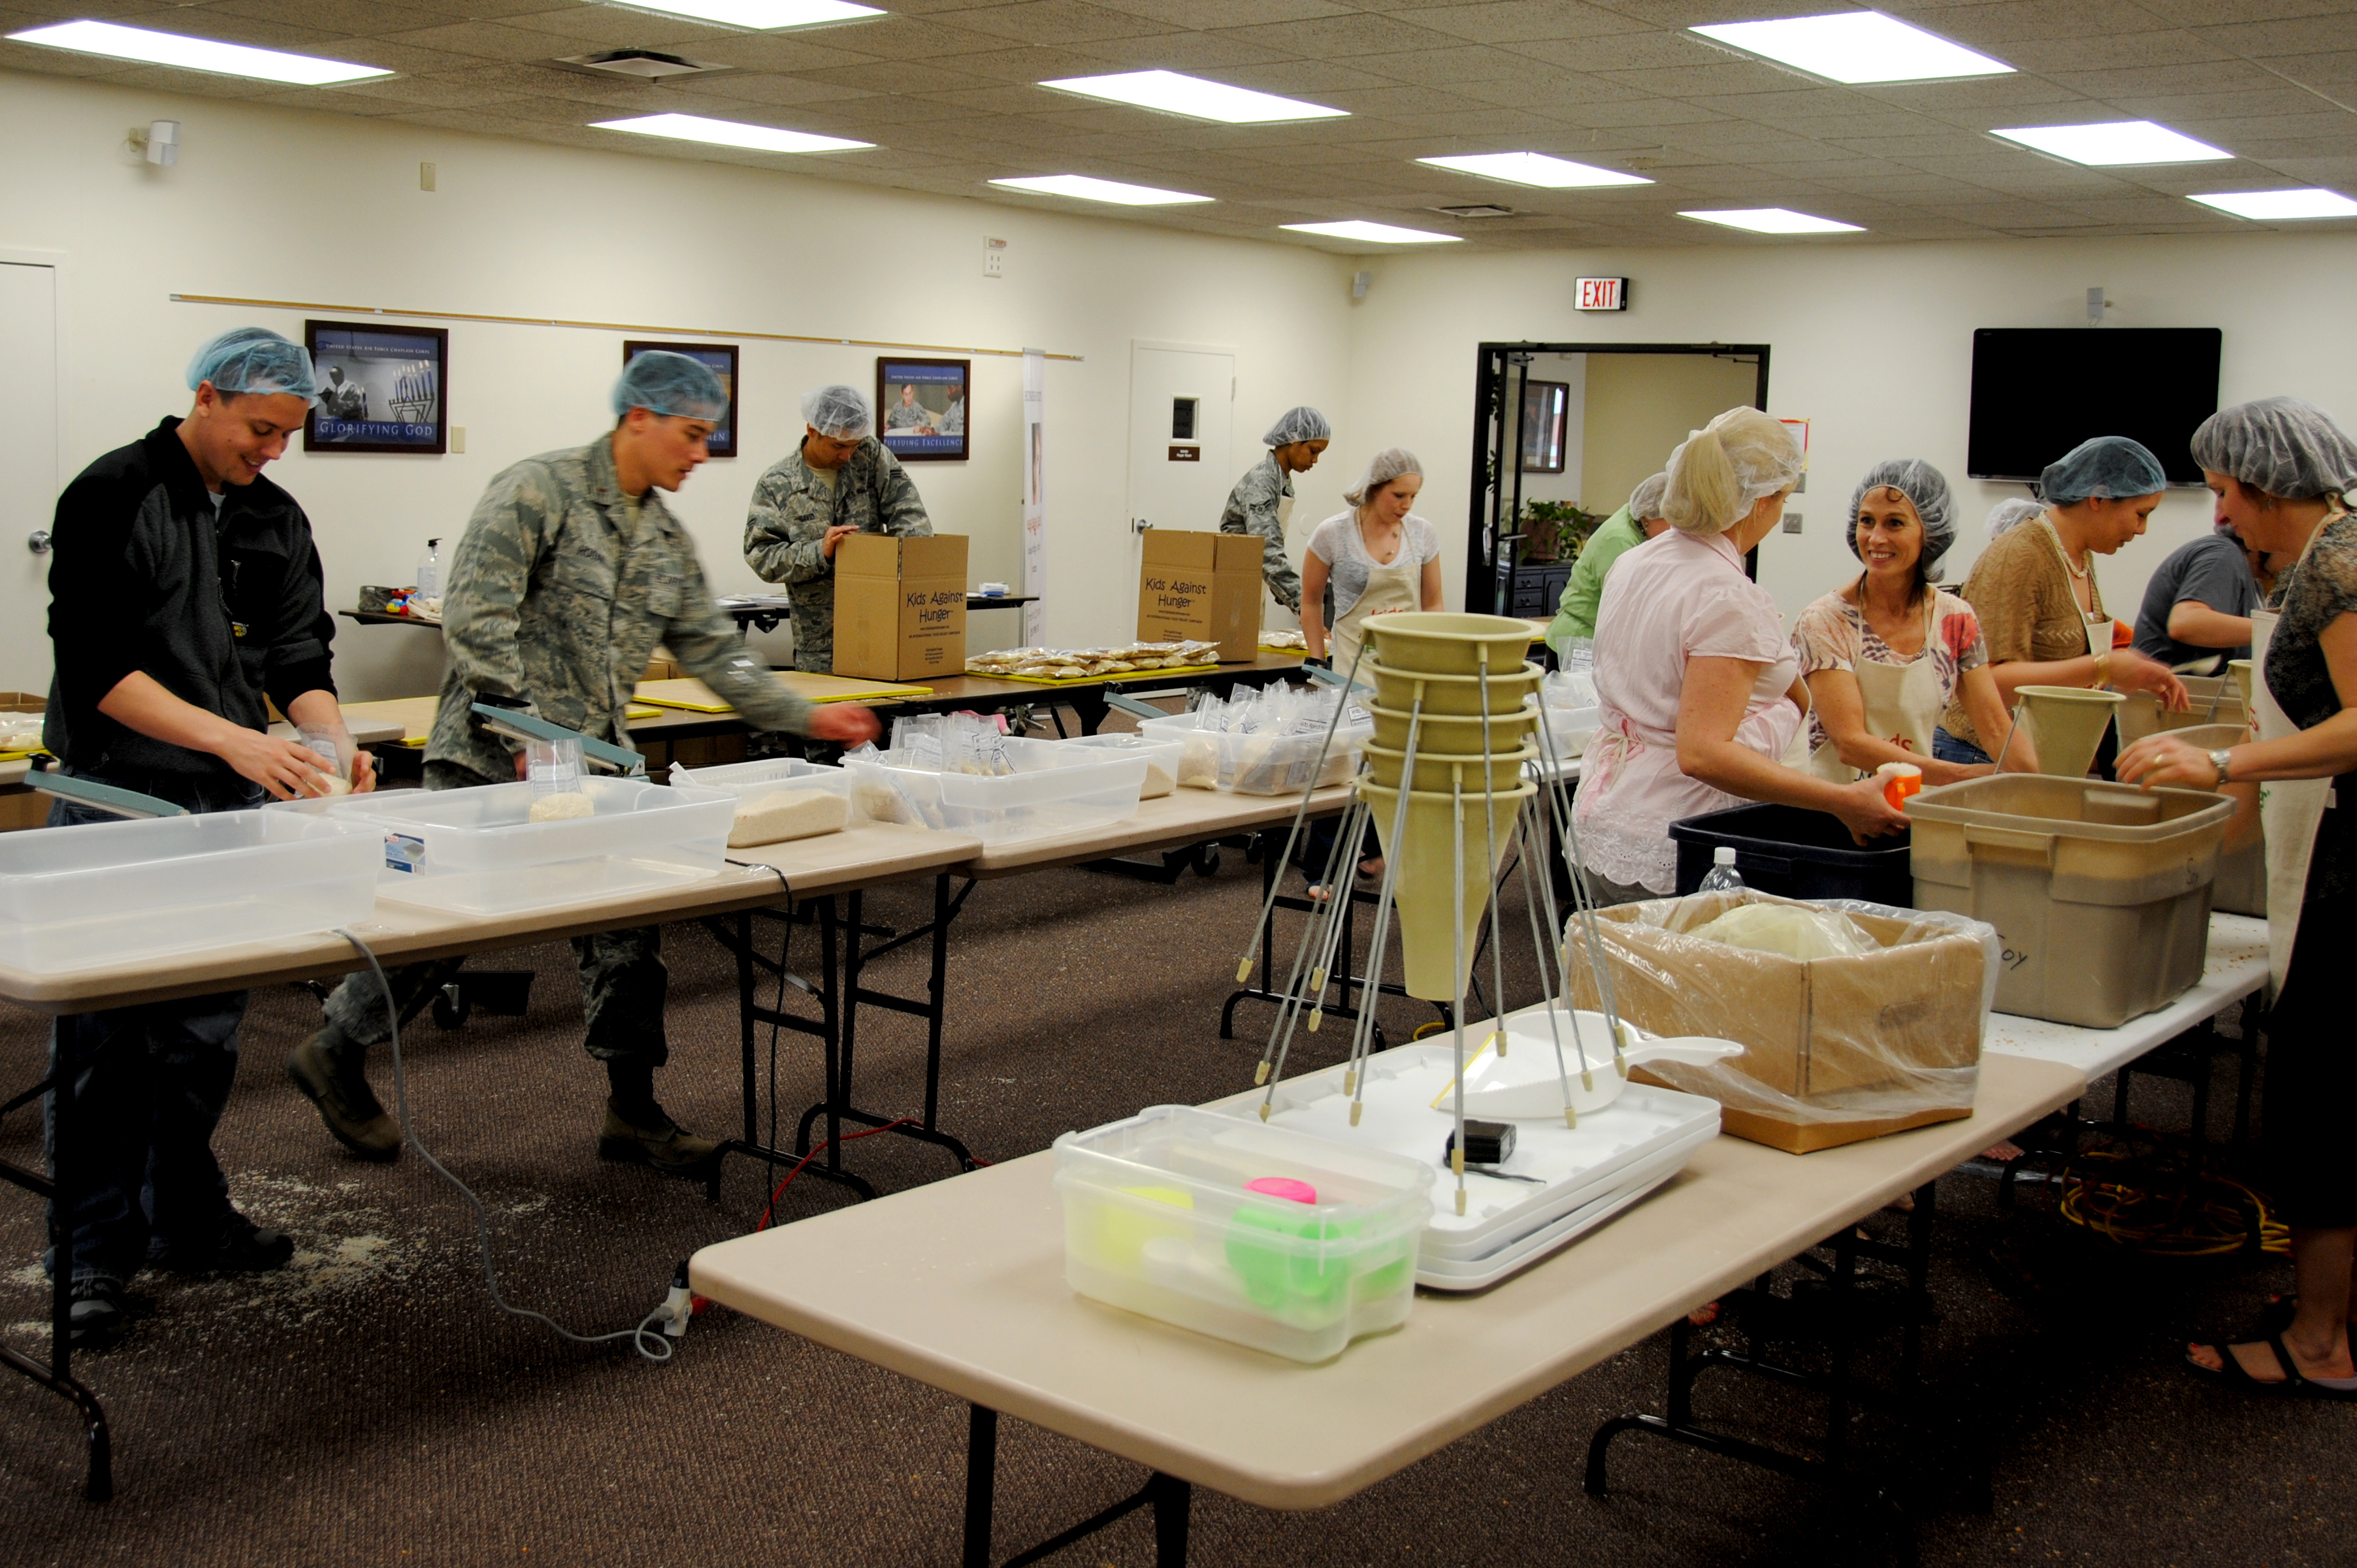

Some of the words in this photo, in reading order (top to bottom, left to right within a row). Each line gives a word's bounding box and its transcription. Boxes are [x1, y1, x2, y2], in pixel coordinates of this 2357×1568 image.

[1583, 281, 1616, 306] EXIT
[319, 421, 398, 434] GLORIFYING
[406, 424, 432, 436] GOD
[1145, 578, 1165, 591] Kids
[1170, 580, 1207, 594] Against
[907, 593, 926, 608] Kids
[930, 591, 963, 605] Against
[1997, 934, 2028, 971] oy
